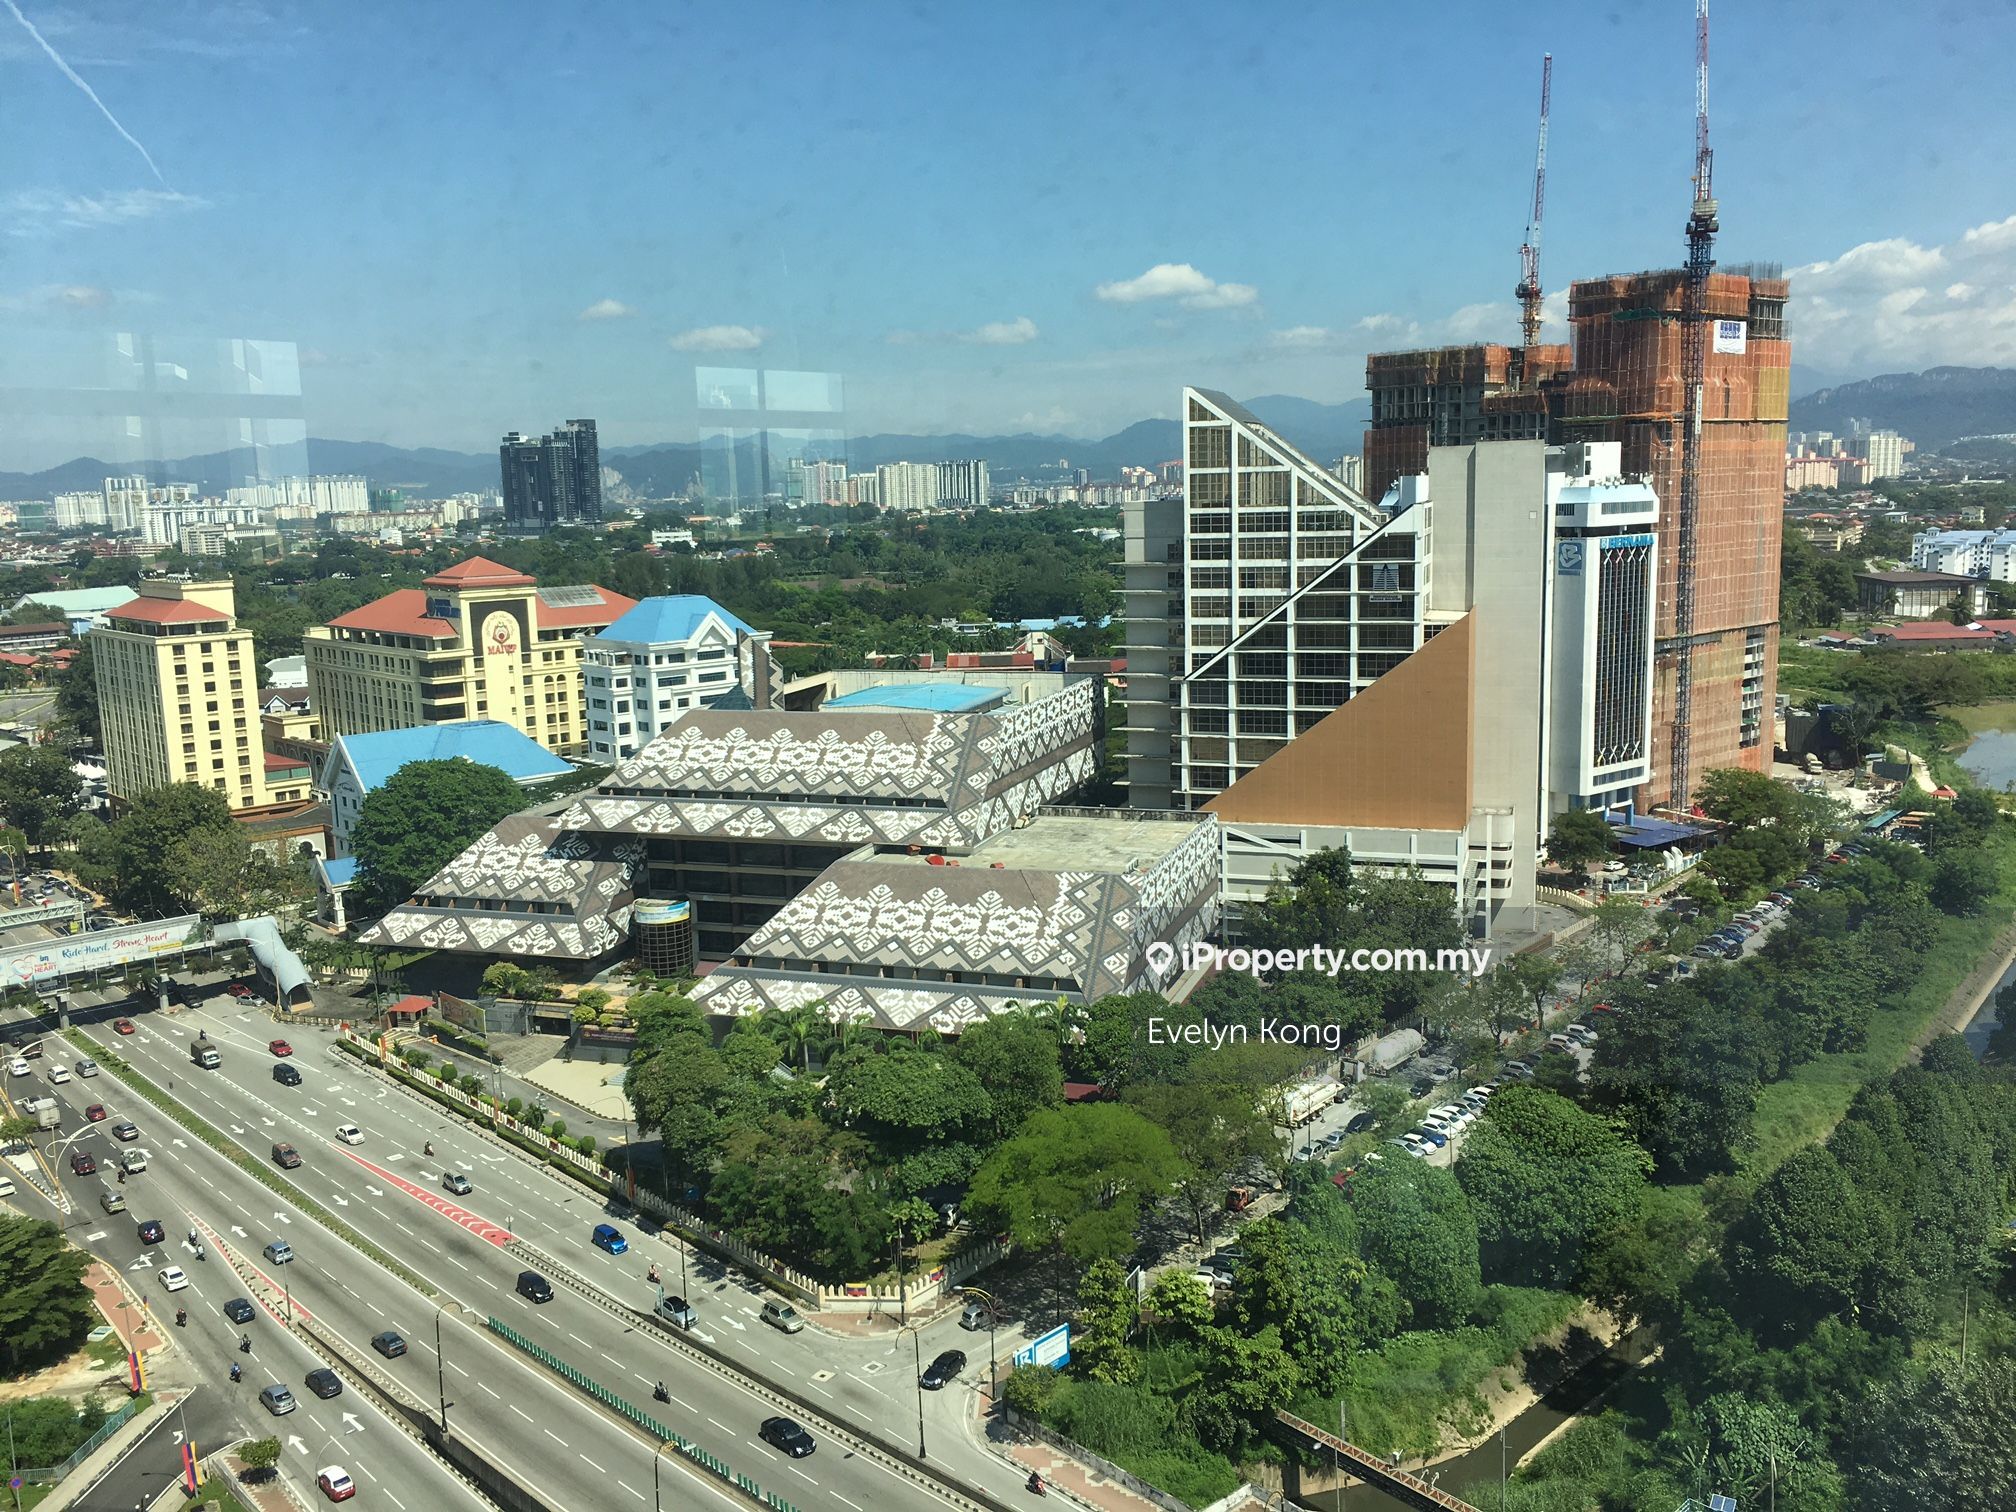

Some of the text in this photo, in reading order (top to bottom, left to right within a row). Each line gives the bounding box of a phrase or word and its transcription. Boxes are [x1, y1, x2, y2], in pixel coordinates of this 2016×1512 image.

[1609, 534, 1654, 549] BERNAMA
[62, 948, 82, 959] Ride
[112, 938, 143, 950] Strong
[143, 931, 168, 944] Heart
[34, 964, 57, 973] HEART
